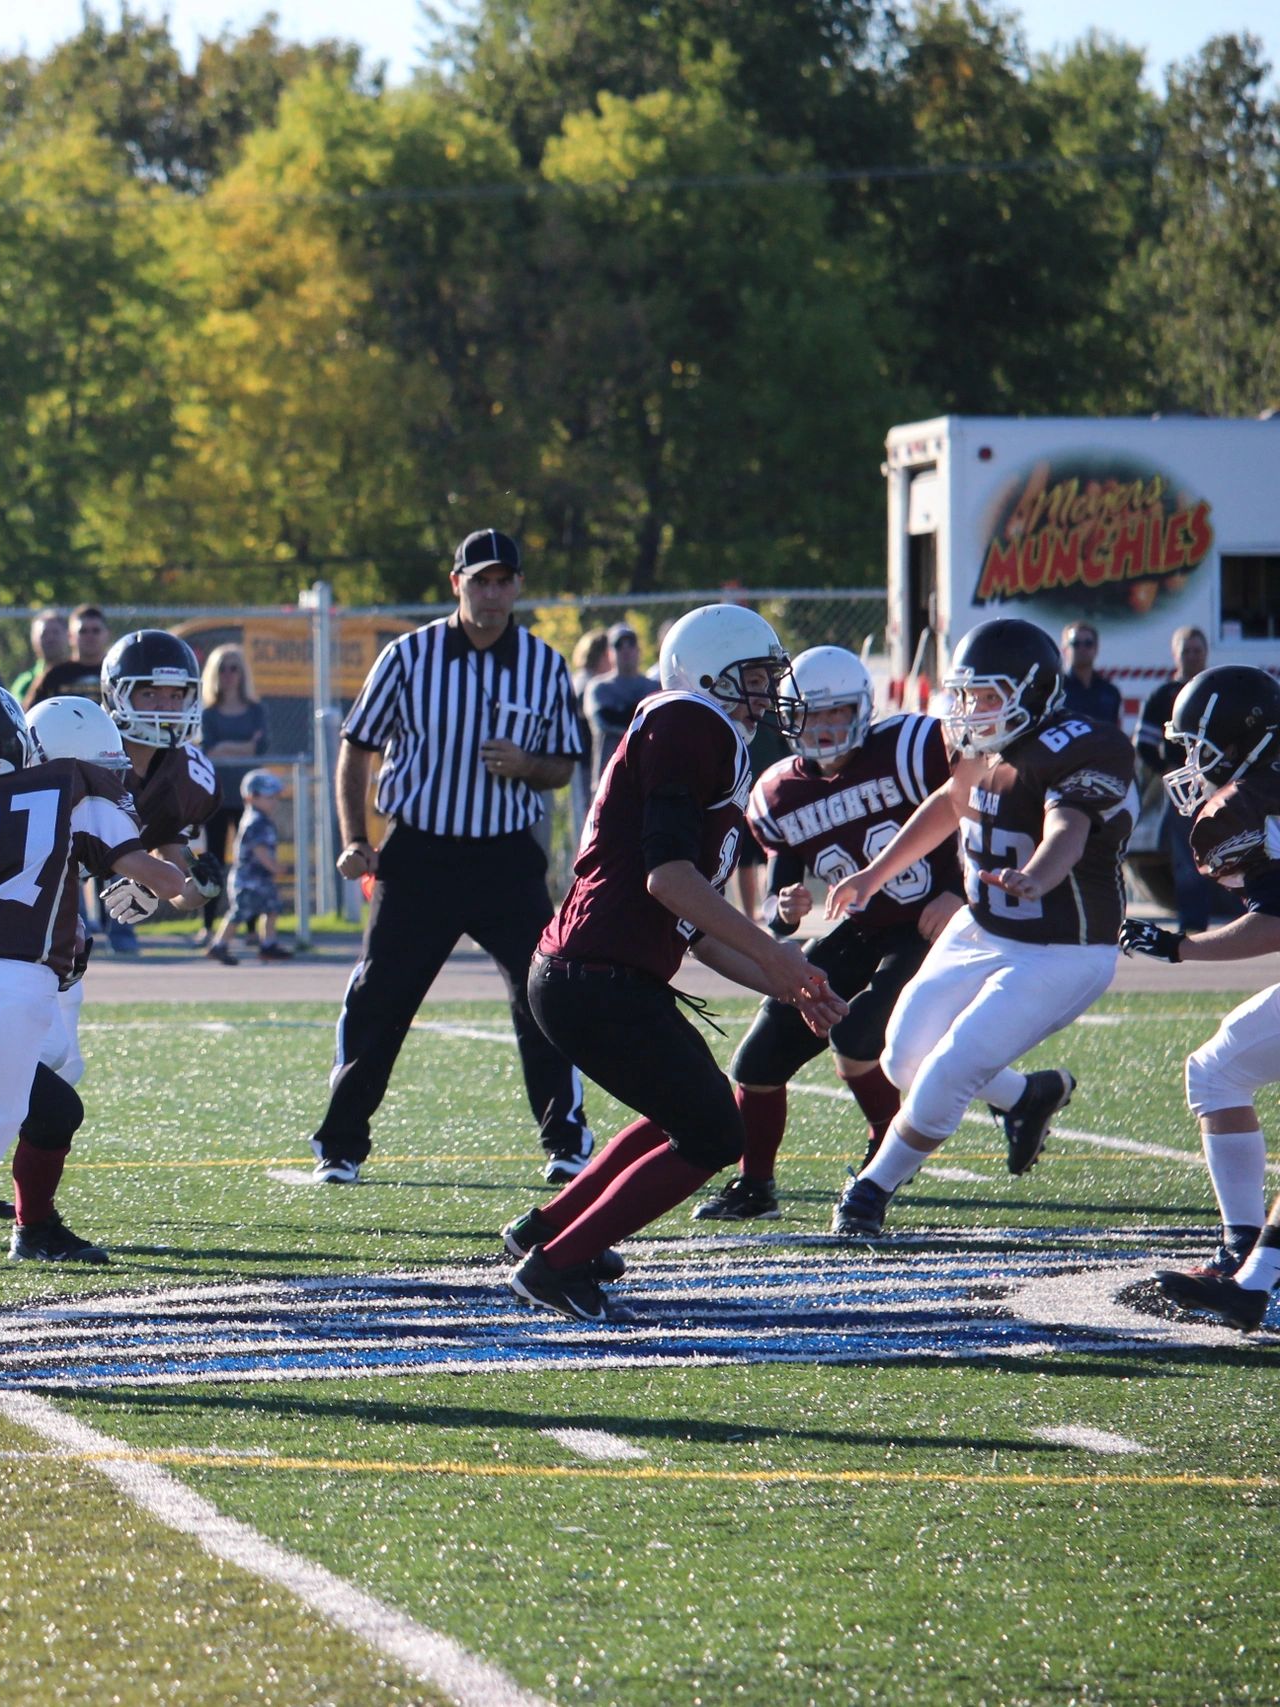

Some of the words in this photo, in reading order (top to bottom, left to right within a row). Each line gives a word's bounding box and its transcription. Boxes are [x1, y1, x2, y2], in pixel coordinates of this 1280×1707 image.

[977, 499, 1212, 598] MUNCHIES
[1038, 719, 1092, 753] 62
[776, 775, 904, 847] KNIGHTS
